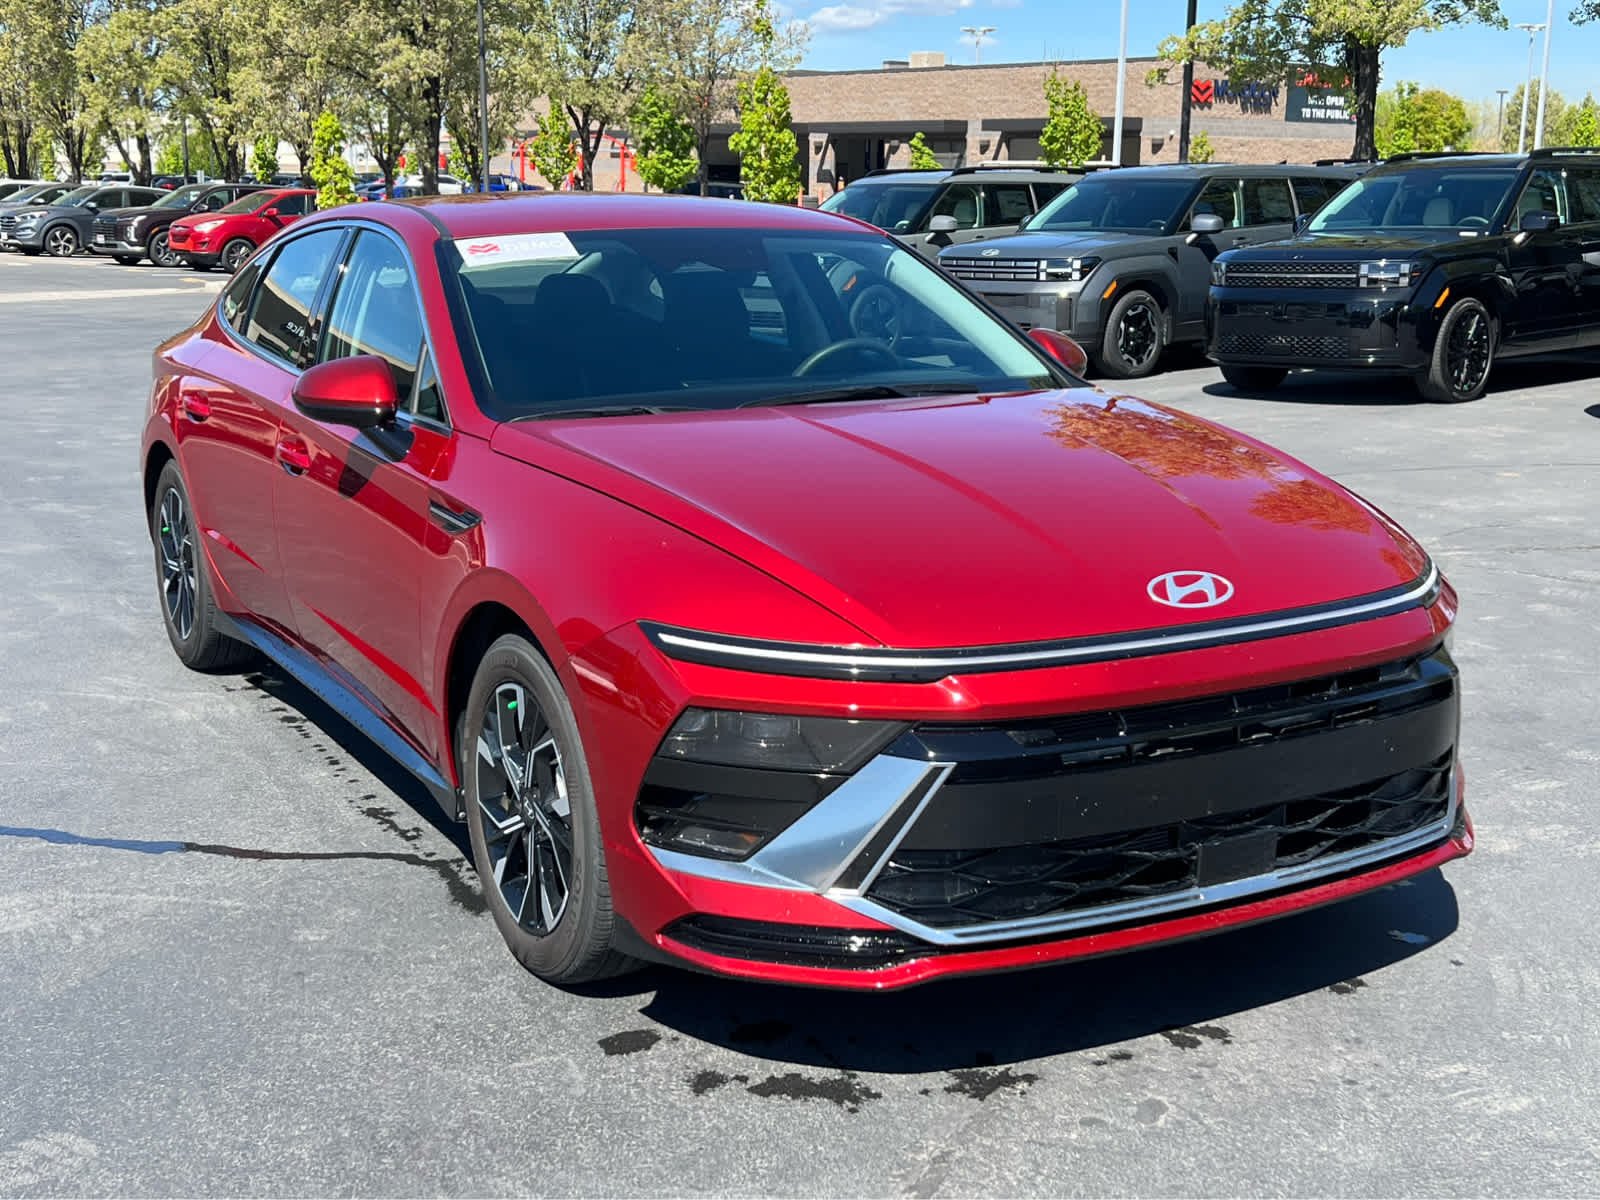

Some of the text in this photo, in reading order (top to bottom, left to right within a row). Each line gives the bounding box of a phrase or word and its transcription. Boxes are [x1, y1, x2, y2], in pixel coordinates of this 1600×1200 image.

[1326, 95, 1344, 106] OPEN
[1301, 108, 1349, 120] TO THE PUBLIC
